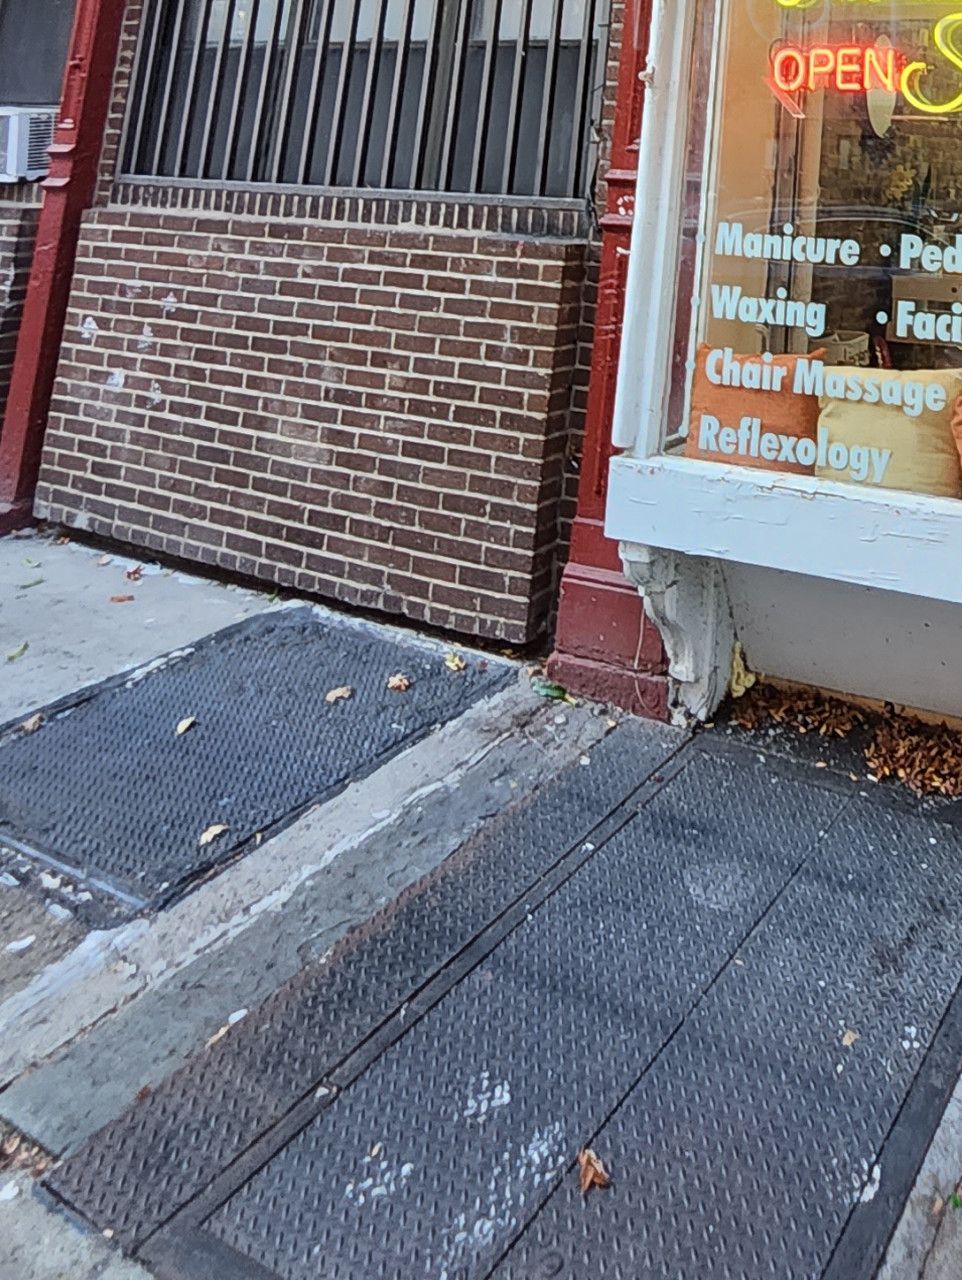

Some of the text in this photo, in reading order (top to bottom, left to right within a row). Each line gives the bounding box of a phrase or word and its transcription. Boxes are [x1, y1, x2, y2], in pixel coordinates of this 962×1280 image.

[773, 45, 897, 94] OPEN
[714, 221, 860, 266] Manicure
[711, 284, 827, 338] Waxing
[705, 348, 947, 418] Chair Massage
[698, 414, 892, 484] Reflexology
